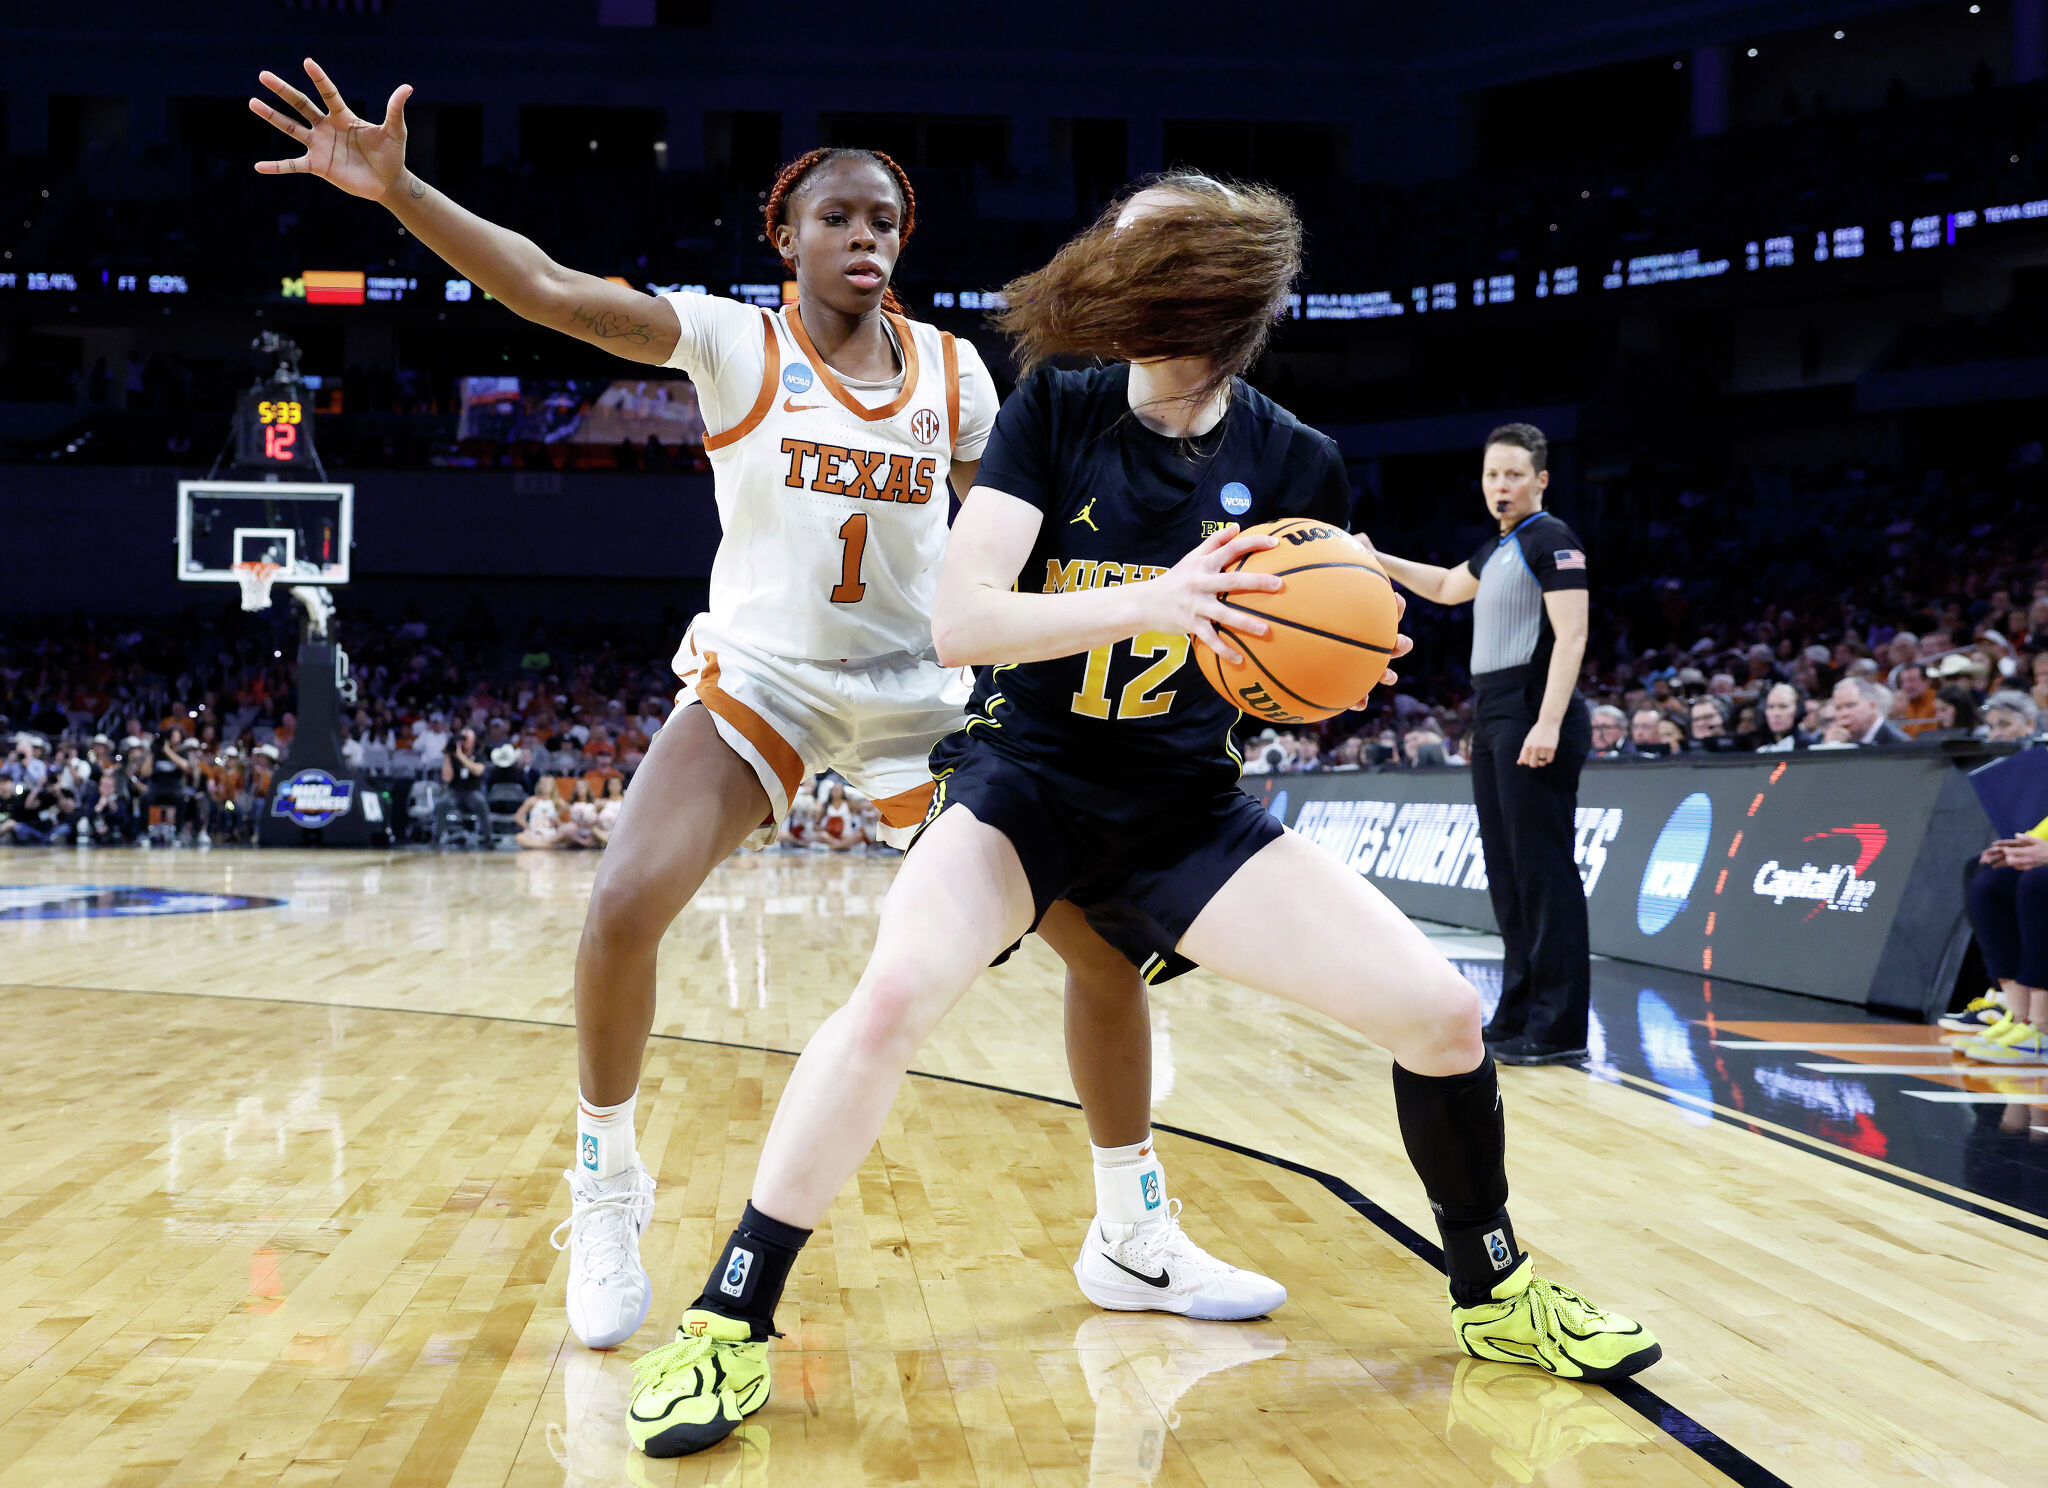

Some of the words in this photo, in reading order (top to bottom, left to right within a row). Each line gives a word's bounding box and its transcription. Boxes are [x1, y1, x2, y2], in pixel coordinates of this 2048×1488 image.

[784, 374, 811, 388] NCAA
[258, 401, 302, 424] 5:33
[912, 409, 940, 444] SEC
[265, 424, 297, 461] 12
[781, 437, 936, 504] TEXAS
[1224, 497, 1250, 508] NCAA
[829, 513, 868, 604] 1
[1042, 558, 1170, 594] MICH
[1070, 631, 1191, 720] 12
